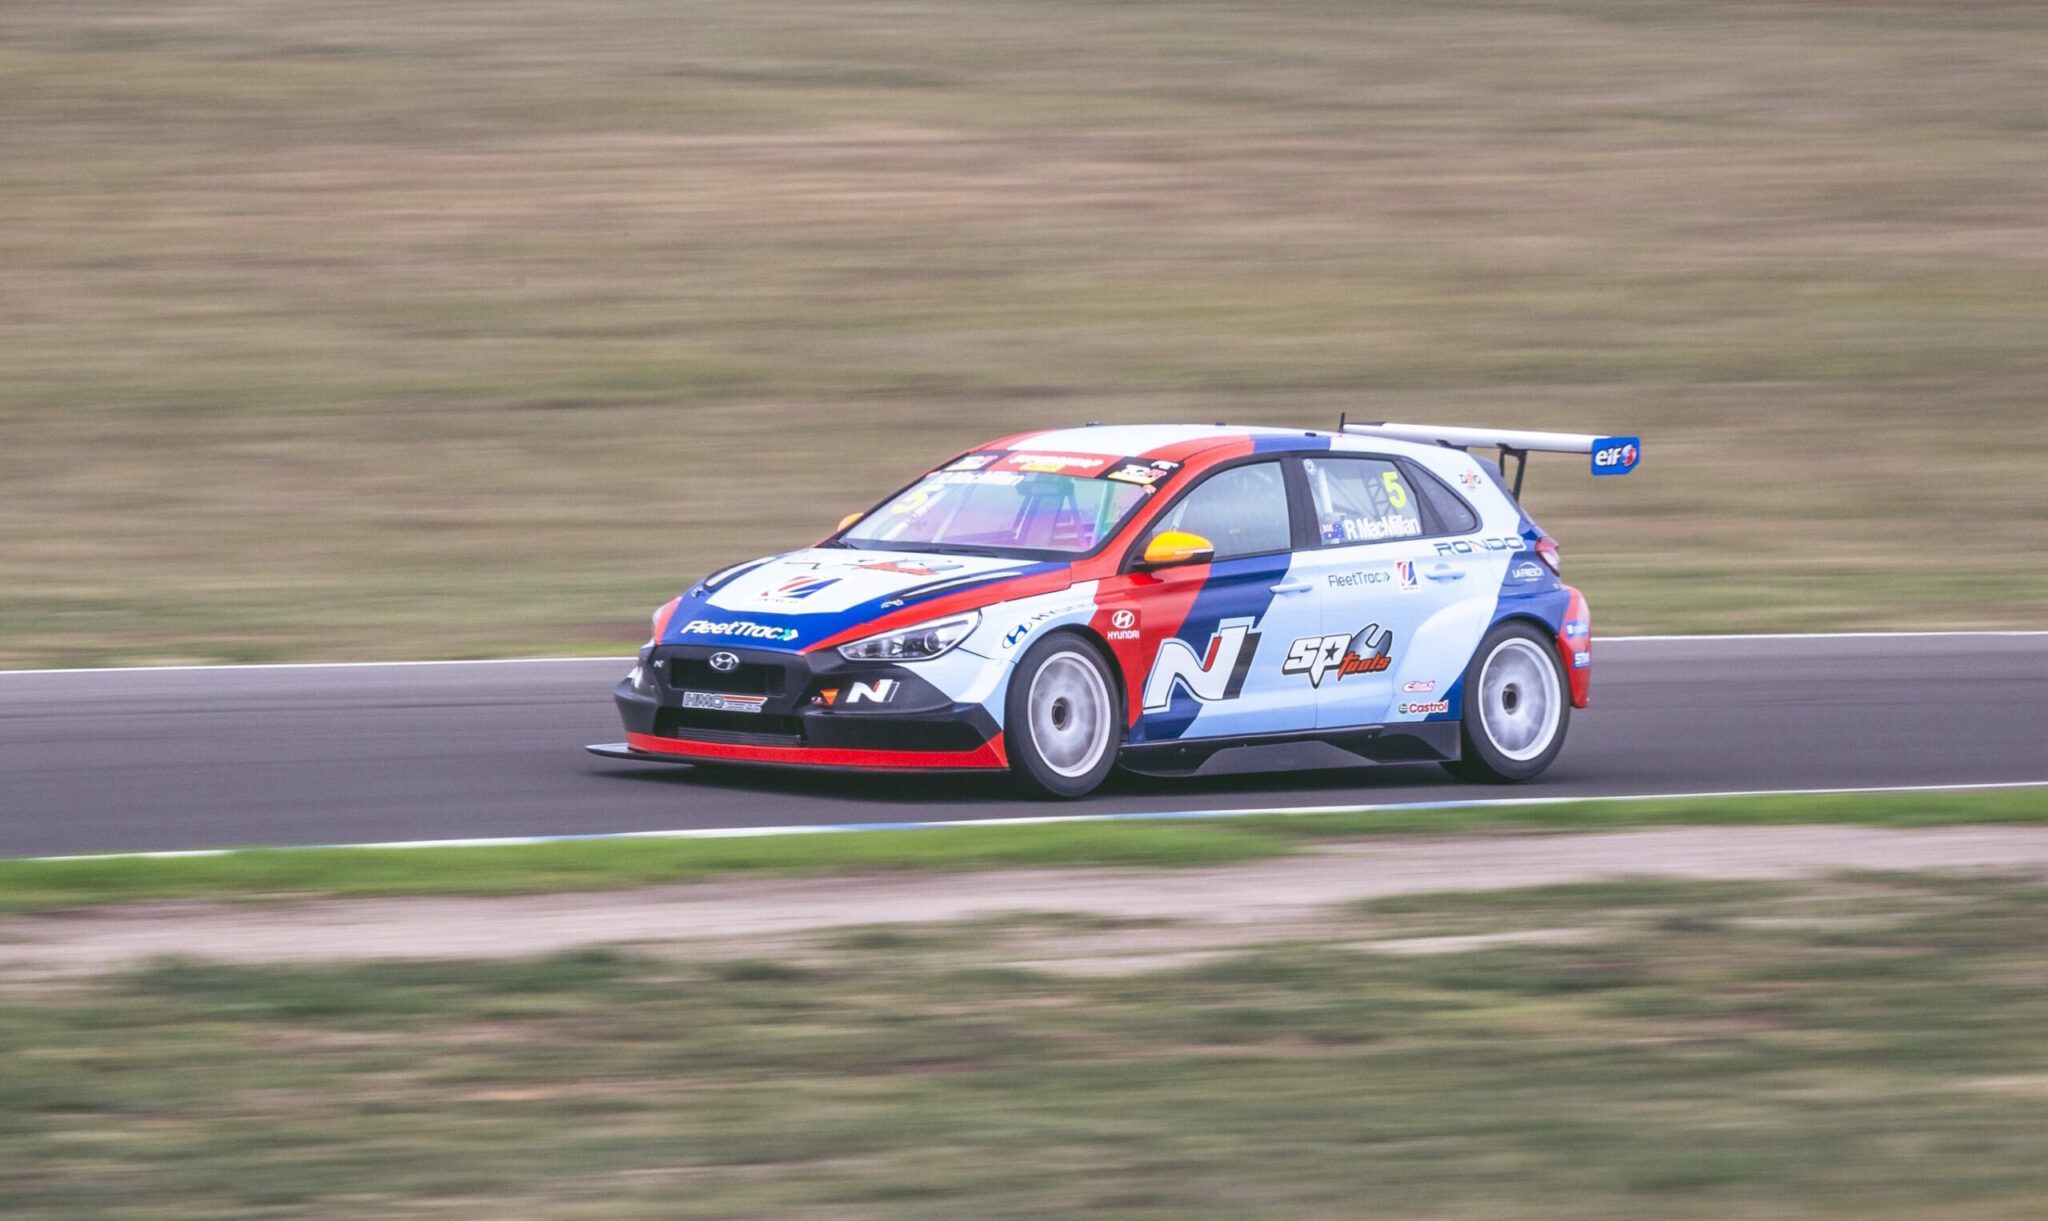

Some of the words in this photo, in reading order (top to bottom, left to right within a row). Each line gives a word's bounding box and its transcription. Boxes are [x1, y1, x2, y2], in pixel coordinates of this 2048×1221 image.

[1594, 447, 1622, 467] elf
[1382, 471, 1406, 509] 5
[1343, 519, 1358, 540] R
[1433, 537, 1525, 557] RONDO
[1327, 571, 1383, 588] FleetTrac
[680, 620, 785, 640] FleetTrac
[1107, 630, 1140, 640] HYUNDAI
[1143, 617, 1262, 713] N
[845, 679, 901, 703] N
[1409, 700, 1449, 714] Castrol
